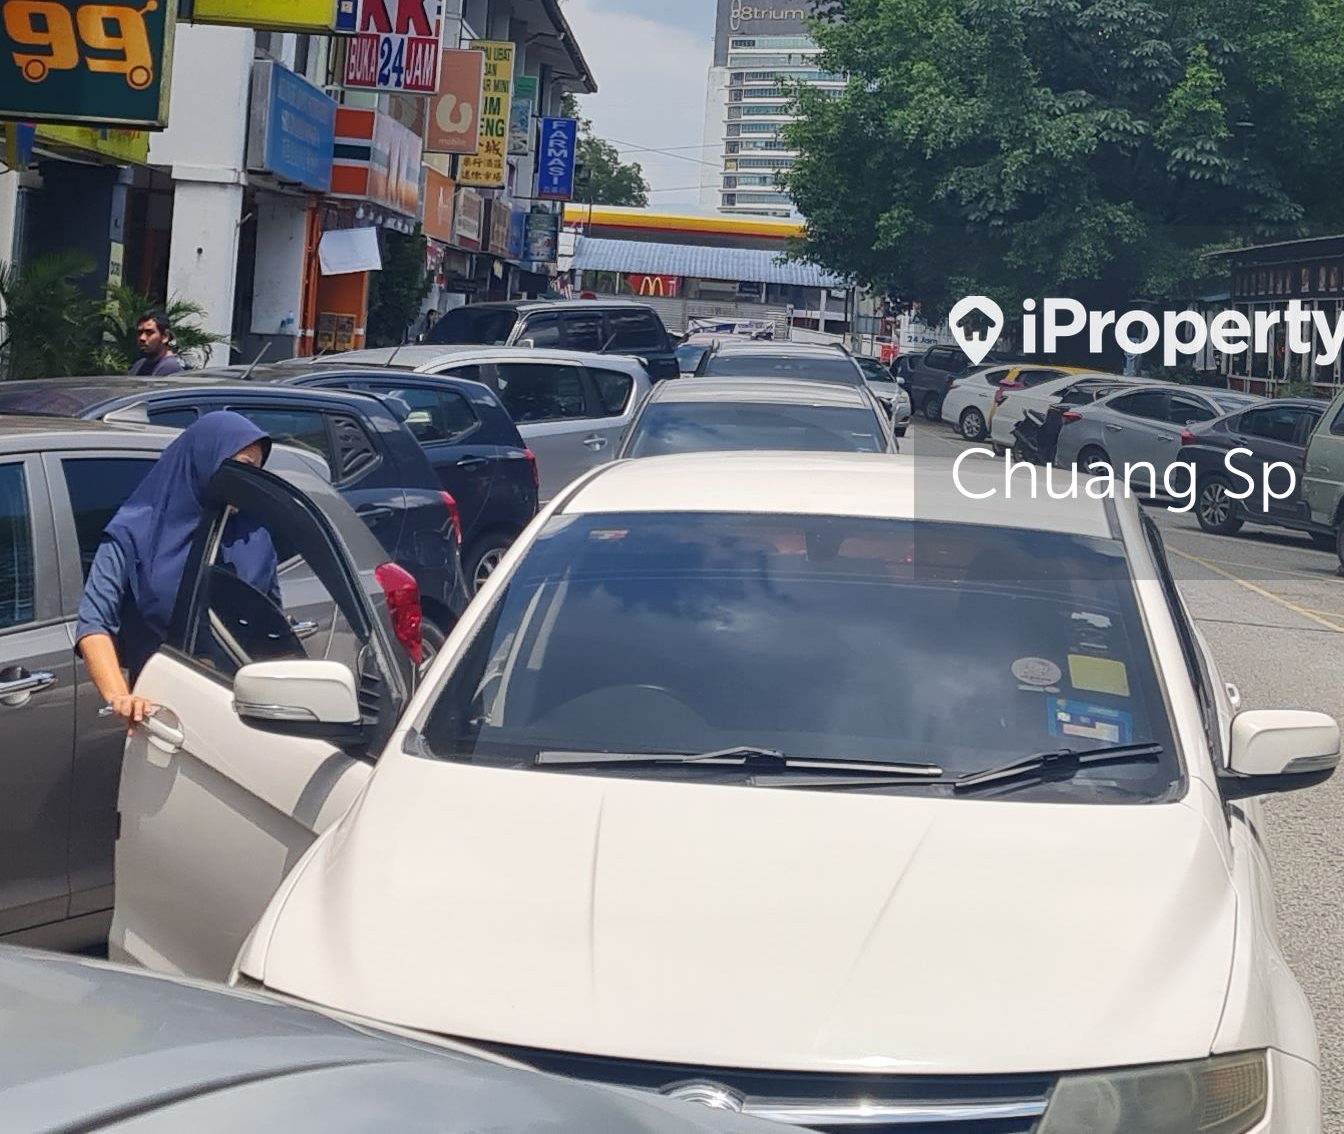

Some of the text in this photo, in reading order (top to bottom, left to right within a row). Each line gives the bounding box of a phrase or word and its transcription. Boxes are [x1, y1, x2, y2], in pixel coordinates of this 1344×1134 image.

[2, 0, 157, 89] 99
[348, 37, 435, 87] BUKA 24 JAM
[547, 120, 568, 185] FARMASI
